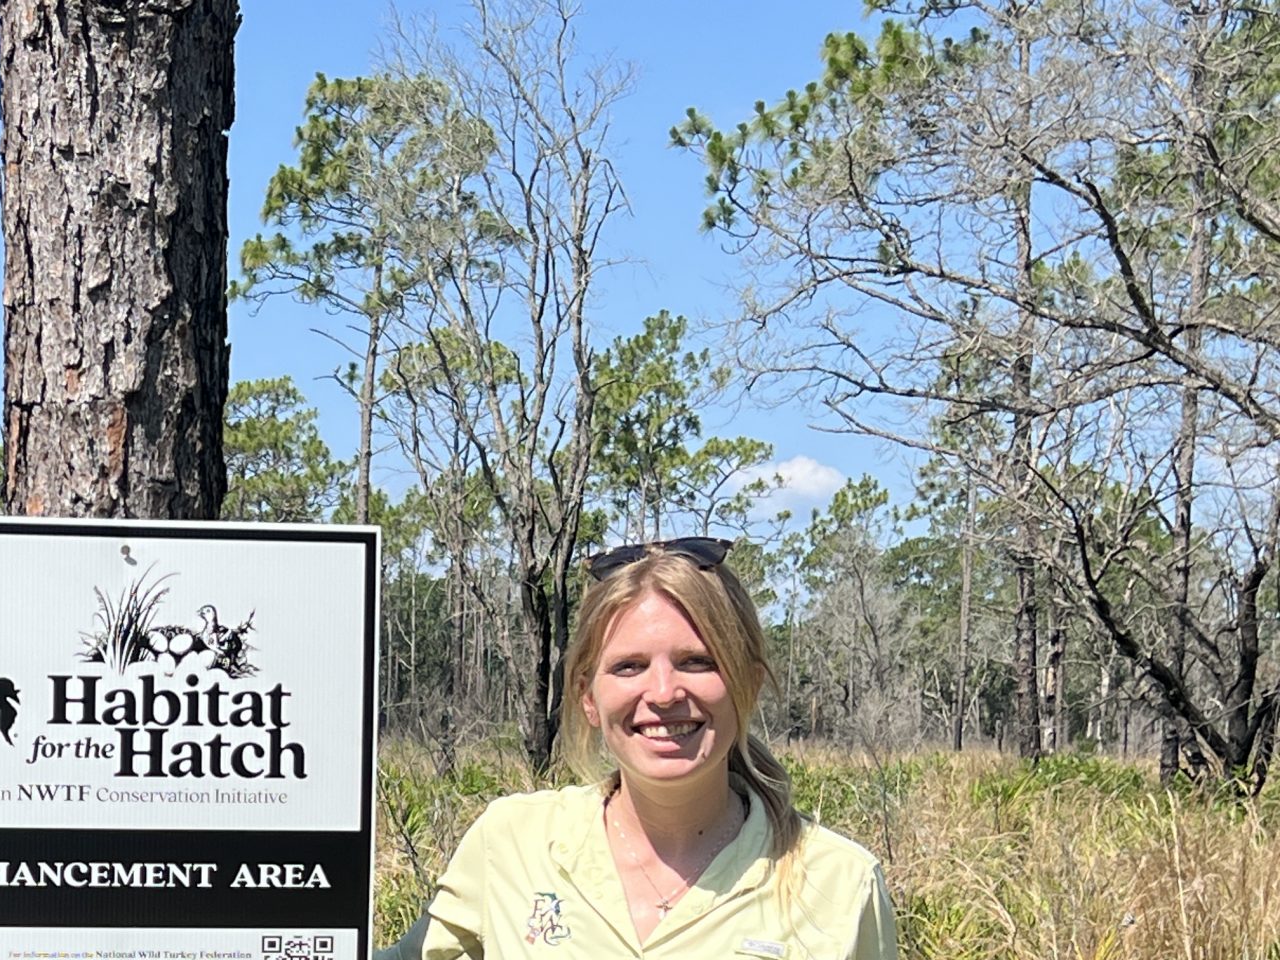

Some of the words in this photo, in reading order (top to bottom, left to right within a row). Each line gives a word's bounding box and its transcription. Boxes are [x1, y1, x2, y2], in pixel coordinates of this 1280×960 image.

[47, 673, 292, 728] Habitat
[25, 735, 73, 764] for
[74, 737, 115, 760] the
[114, 727, 308, 779] Hatch
[17, 784, 92, 802] NWTF
[95, 786, 211, 804] Conservation
[214, 788, 288, 805] Initiative
[230, 864, 332, 889] AREA
[96, 951, 136, 959] National
[138, 951, 161, 959] Wild
[163, 951, 197, 960] Turkey
[199, 951, 252, 959] Federation
